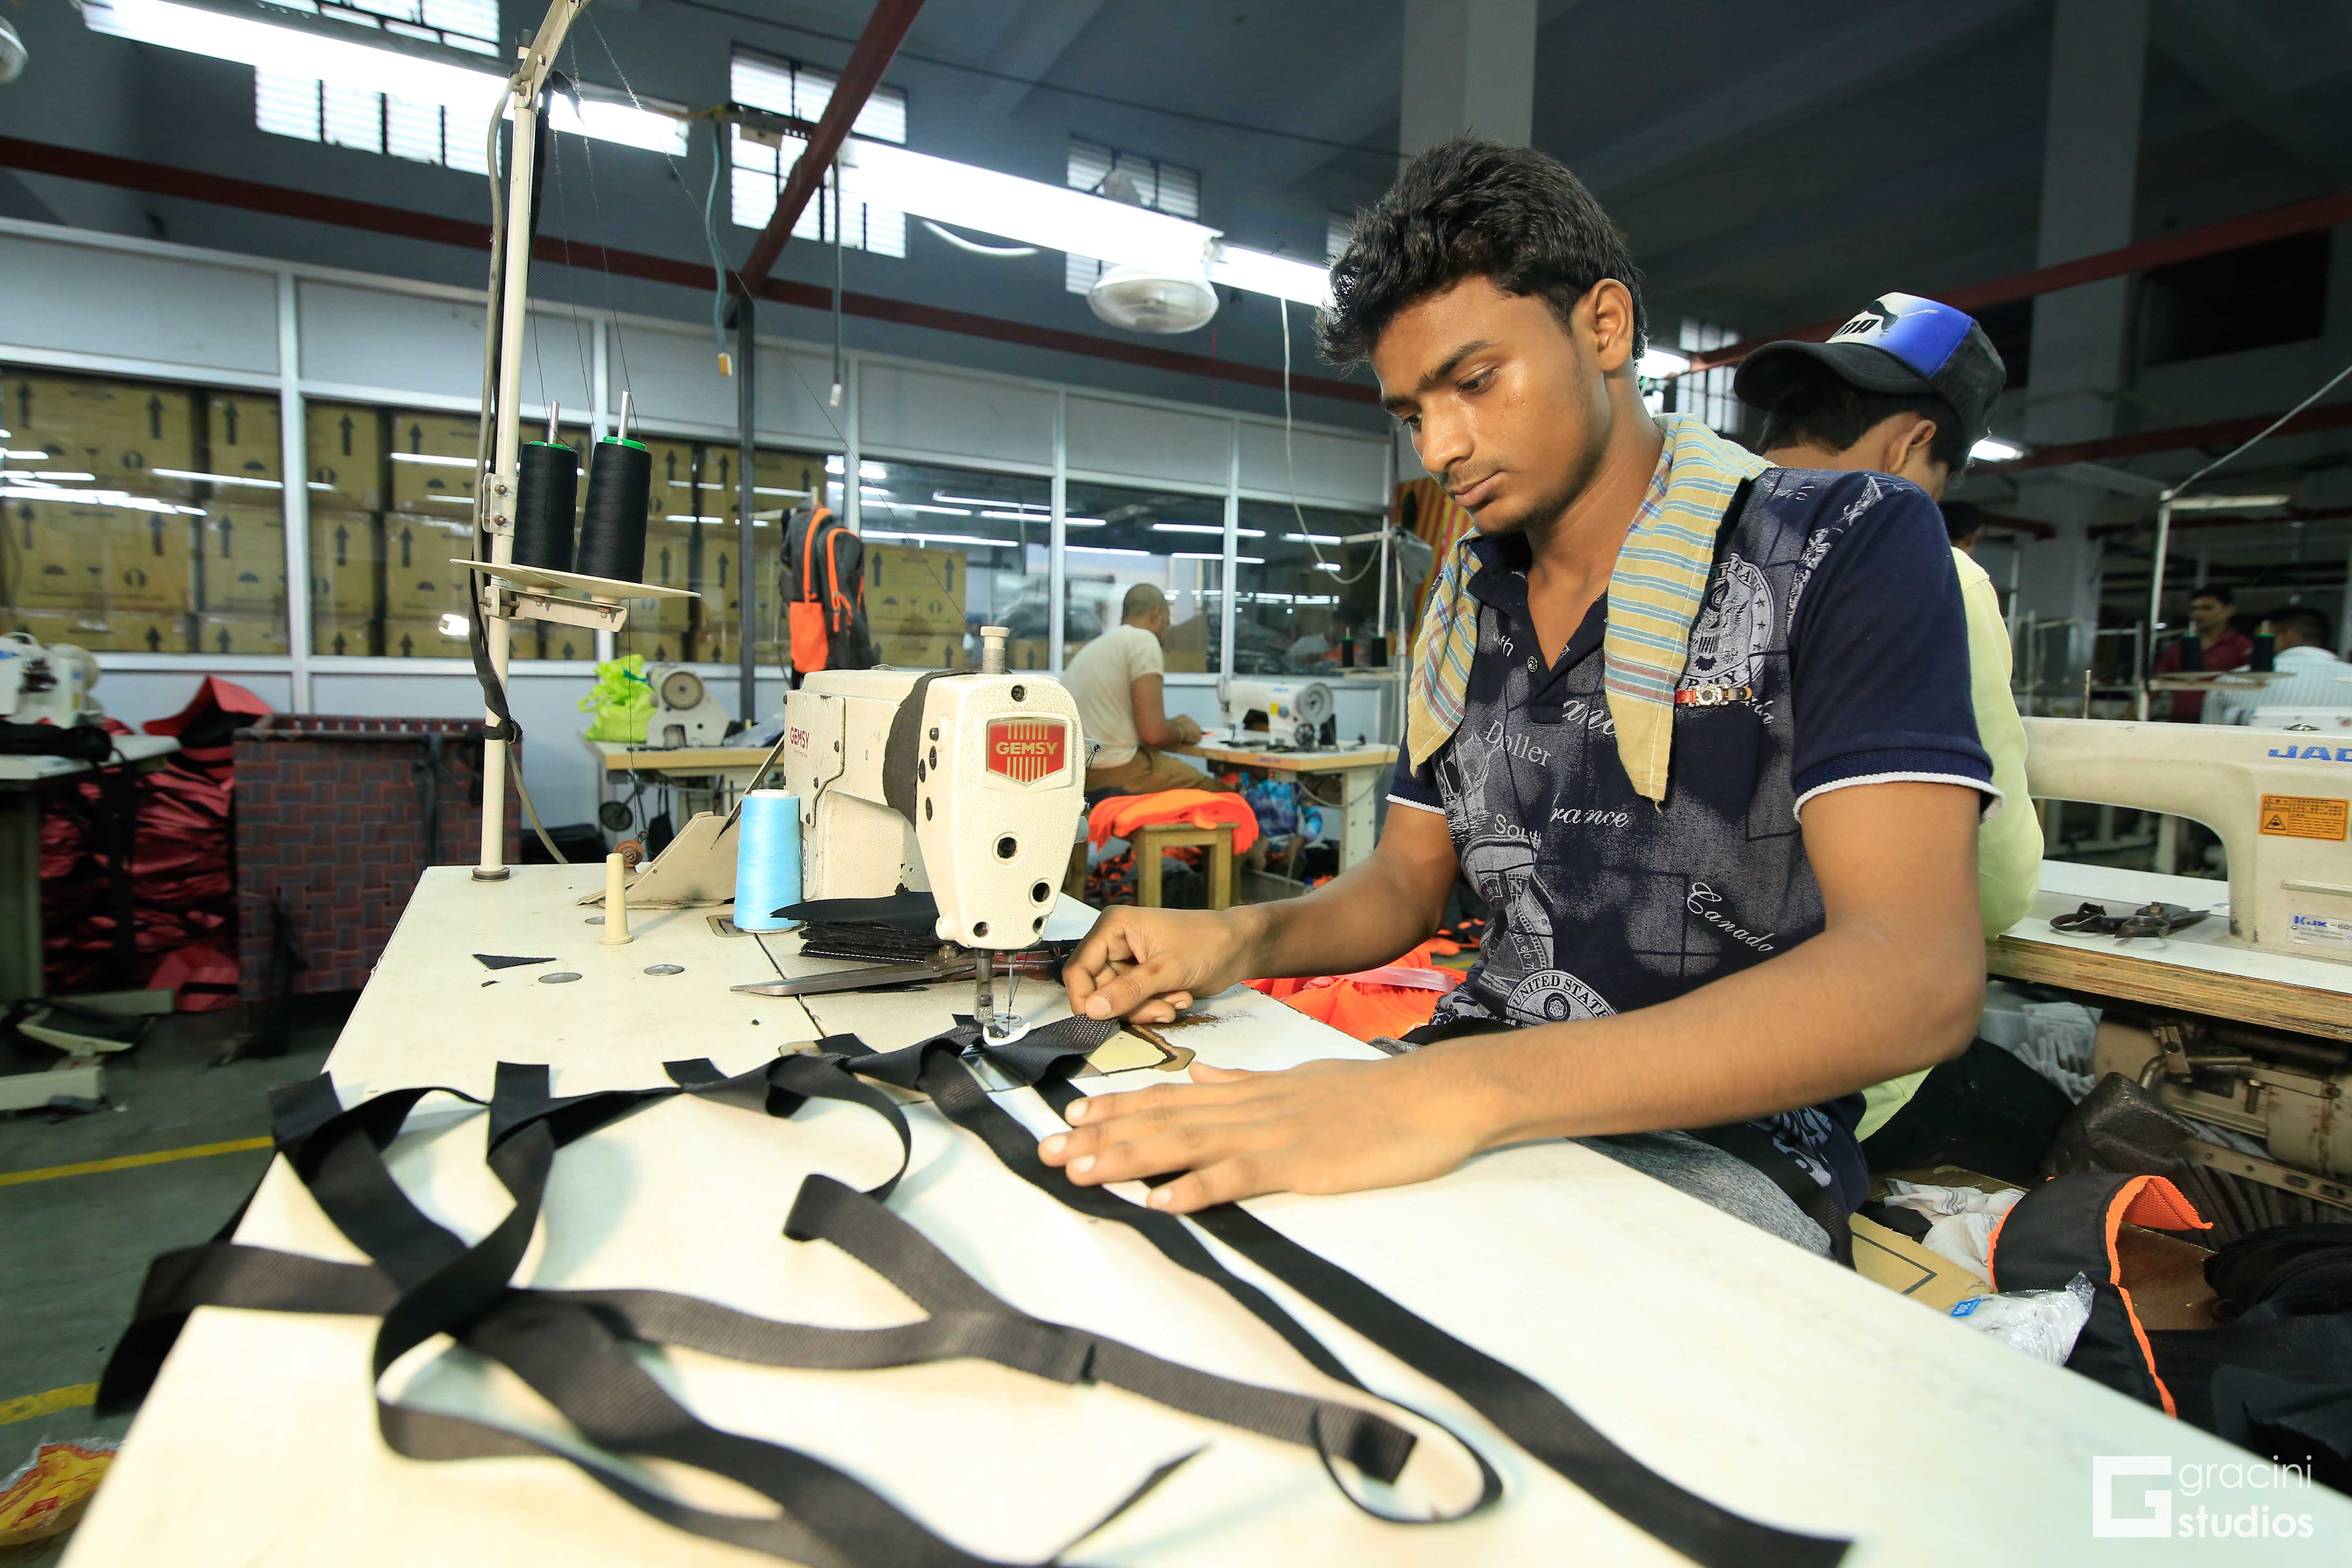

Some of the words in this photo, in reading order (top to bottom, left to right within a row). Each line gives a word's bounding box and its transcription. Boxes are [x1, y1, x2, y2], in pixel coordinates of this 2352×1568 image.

[790, 726, 809, 750] GEMSY
[996, 741, 1058, 755] GEMSY
[1484, 719, 1551, 767] Doller
[1513, 975, 1561, 1006] UNITED
